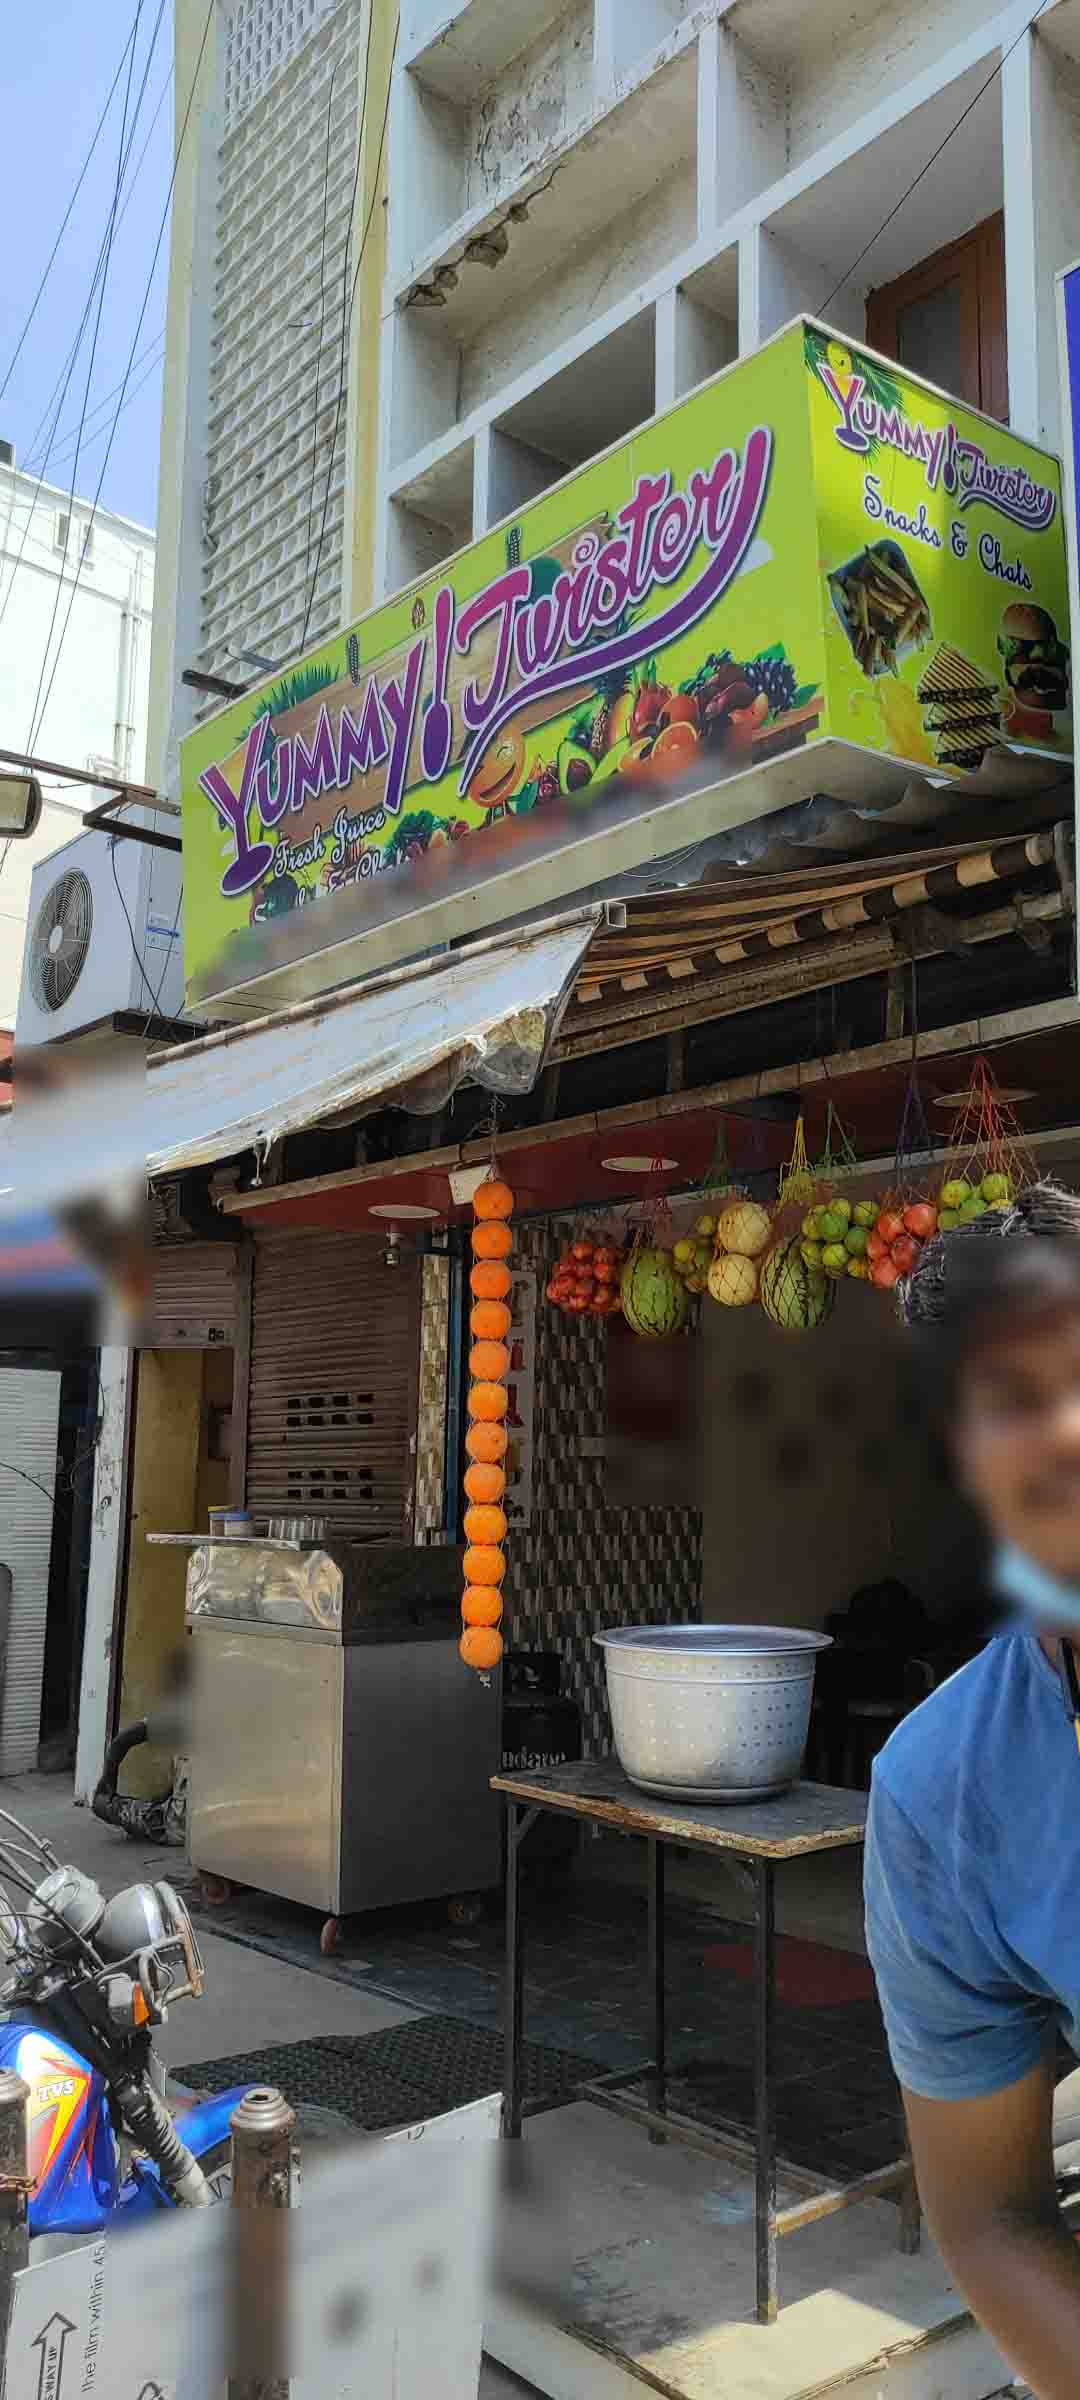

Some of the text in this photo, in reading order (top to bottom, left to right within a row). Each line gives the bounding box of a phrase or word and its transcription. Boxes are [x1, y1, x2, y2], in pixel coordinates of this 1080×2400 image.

[863, 474, 1033, 591] Snacks & Chats
[274, 823, 325, 878] Fresh
[331, 806, 386, 864] Juice
[39, 2080, 74, 2102] TVS
[88, 2271, 105, 2325] within
[83, 2327, 101, 2359] film
[45, 2363, 58, 2393] WAY
